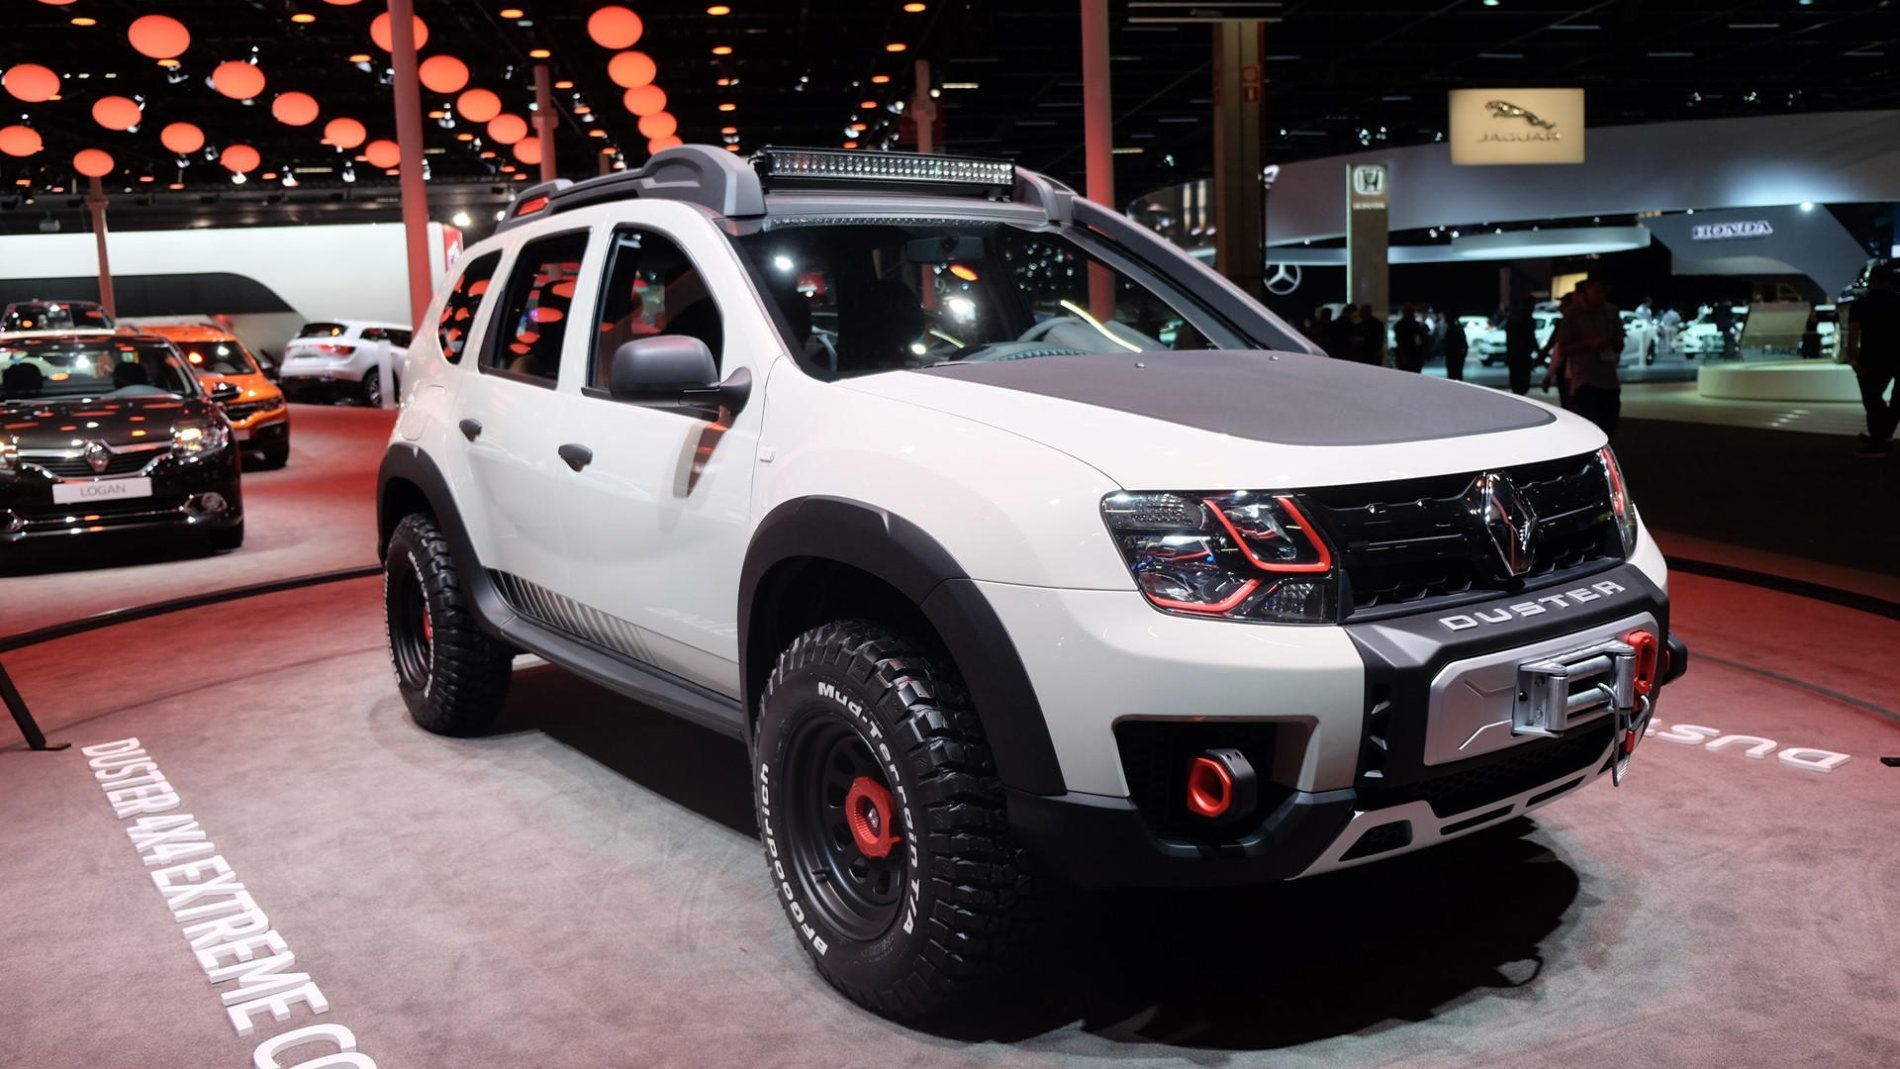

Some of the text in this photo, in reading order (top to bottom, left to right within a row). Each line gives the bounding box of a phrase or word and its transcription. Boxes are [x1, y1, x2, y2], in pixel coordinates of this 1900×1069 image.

[1477, 132, 1561, 143] JAGUAR
[1692, 220, 1773, 240] HONDA
[80, 484, 126, 497] LOGAN
[1438, 580, 1626, 632] DUSTER
[817, 681, 919, 868] Mud-Terrain
[902, 877, 921, 935] T/A
[761, 763, 829, 957] BFGoodrich
[81, 737, 181, 819] DUSTER
[150, 855, 329, 1037] EXTREME
